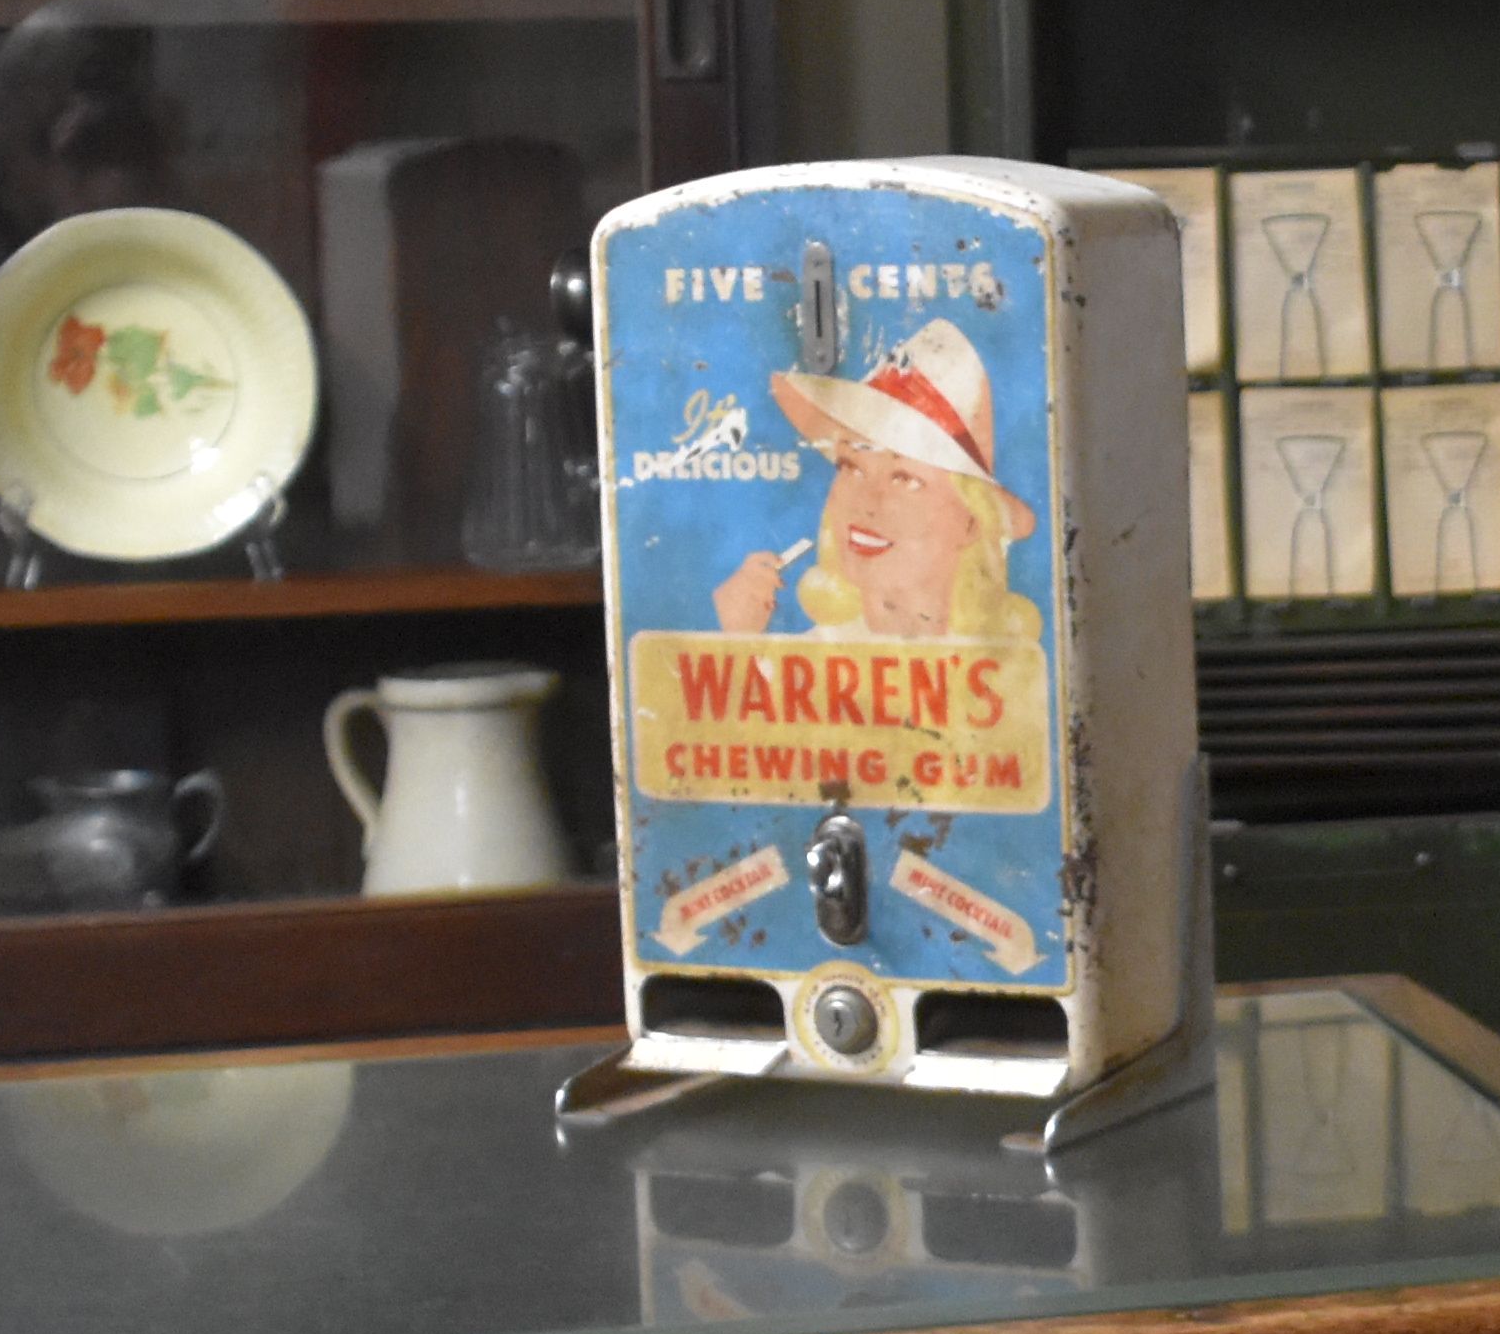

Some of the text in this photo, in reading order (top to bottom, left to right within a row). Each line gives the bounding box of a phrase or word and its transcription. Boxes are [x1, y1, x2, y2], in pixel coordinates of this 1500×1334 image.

[664, 262, 998, 304] FIVE CENTS
[633, 451, 800, 480] DELICIOUS
[678, 653, 1004, 729] WARREN'S
[665, 742, 1023, 789] CHEWING GUM
